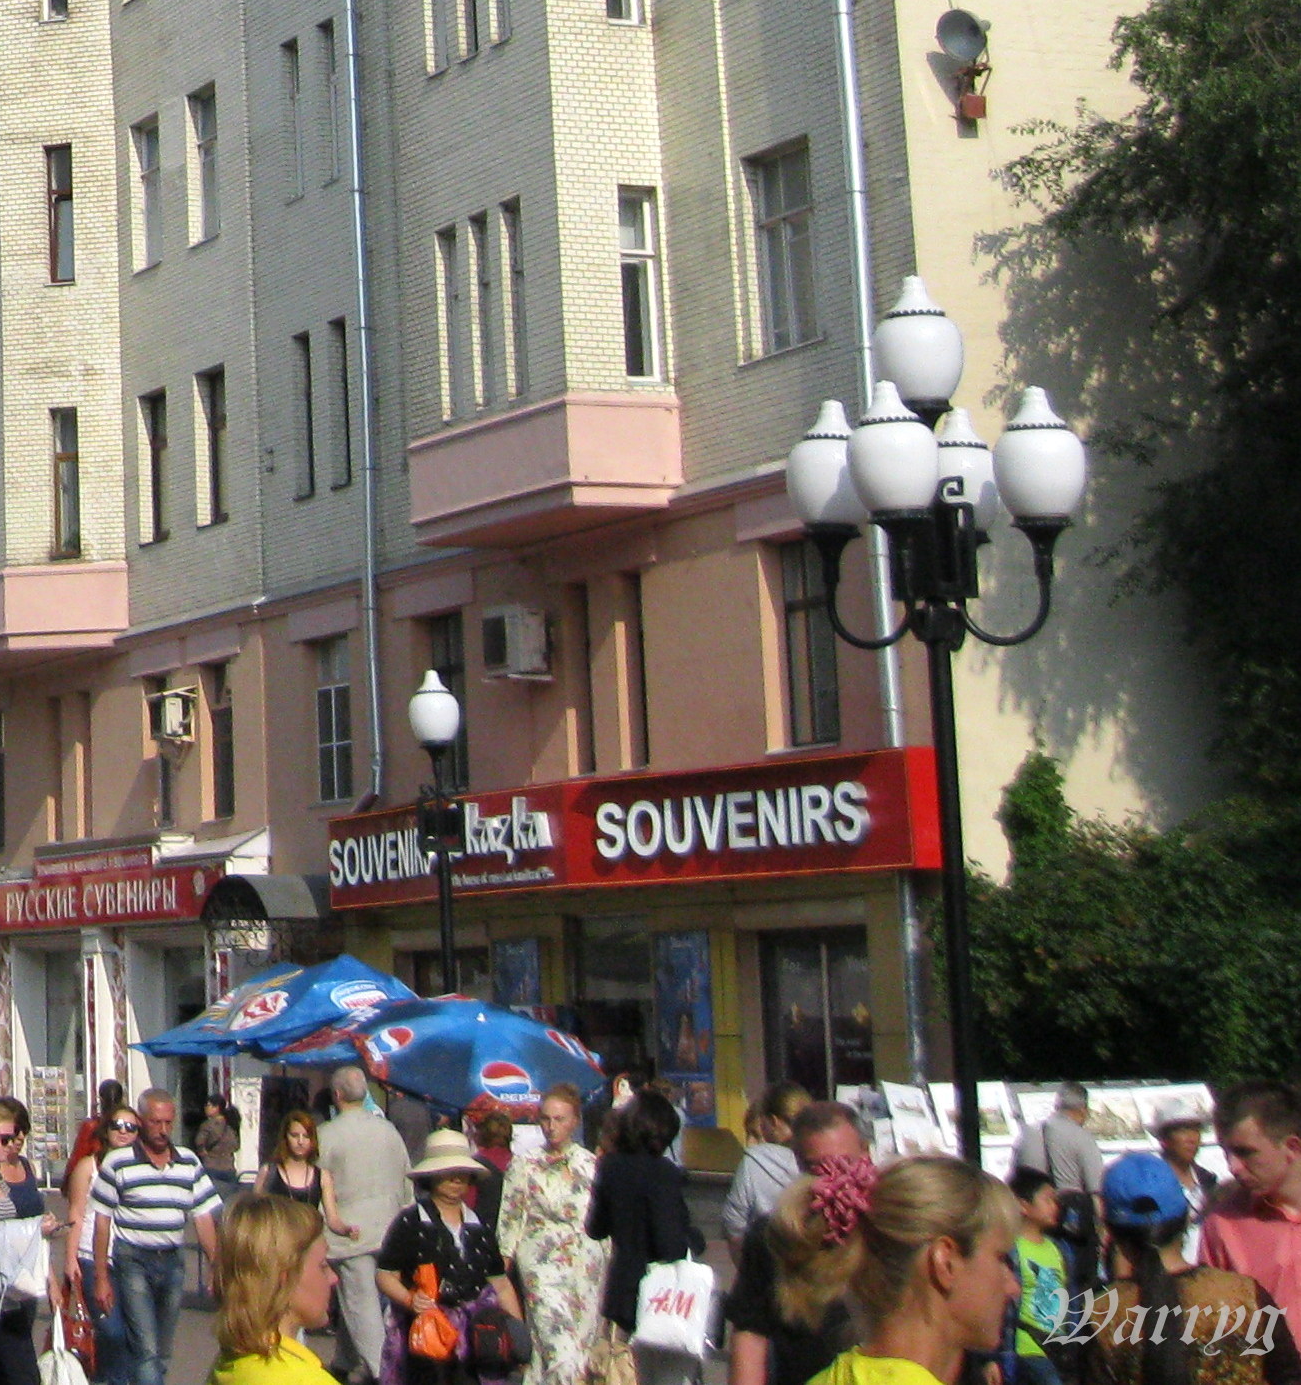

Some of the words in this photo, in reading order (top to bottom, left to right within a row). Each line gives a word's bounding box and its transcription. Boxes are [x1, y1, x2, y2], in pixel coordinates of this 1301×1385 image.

[449, 796, 554, 865] kazka
[595, 780, 872, 860] SOUVENIRS
[5, 886, 78, 923] РУССКИЕ
[82, 876, 178, 918] СУВЕНИРЫ
